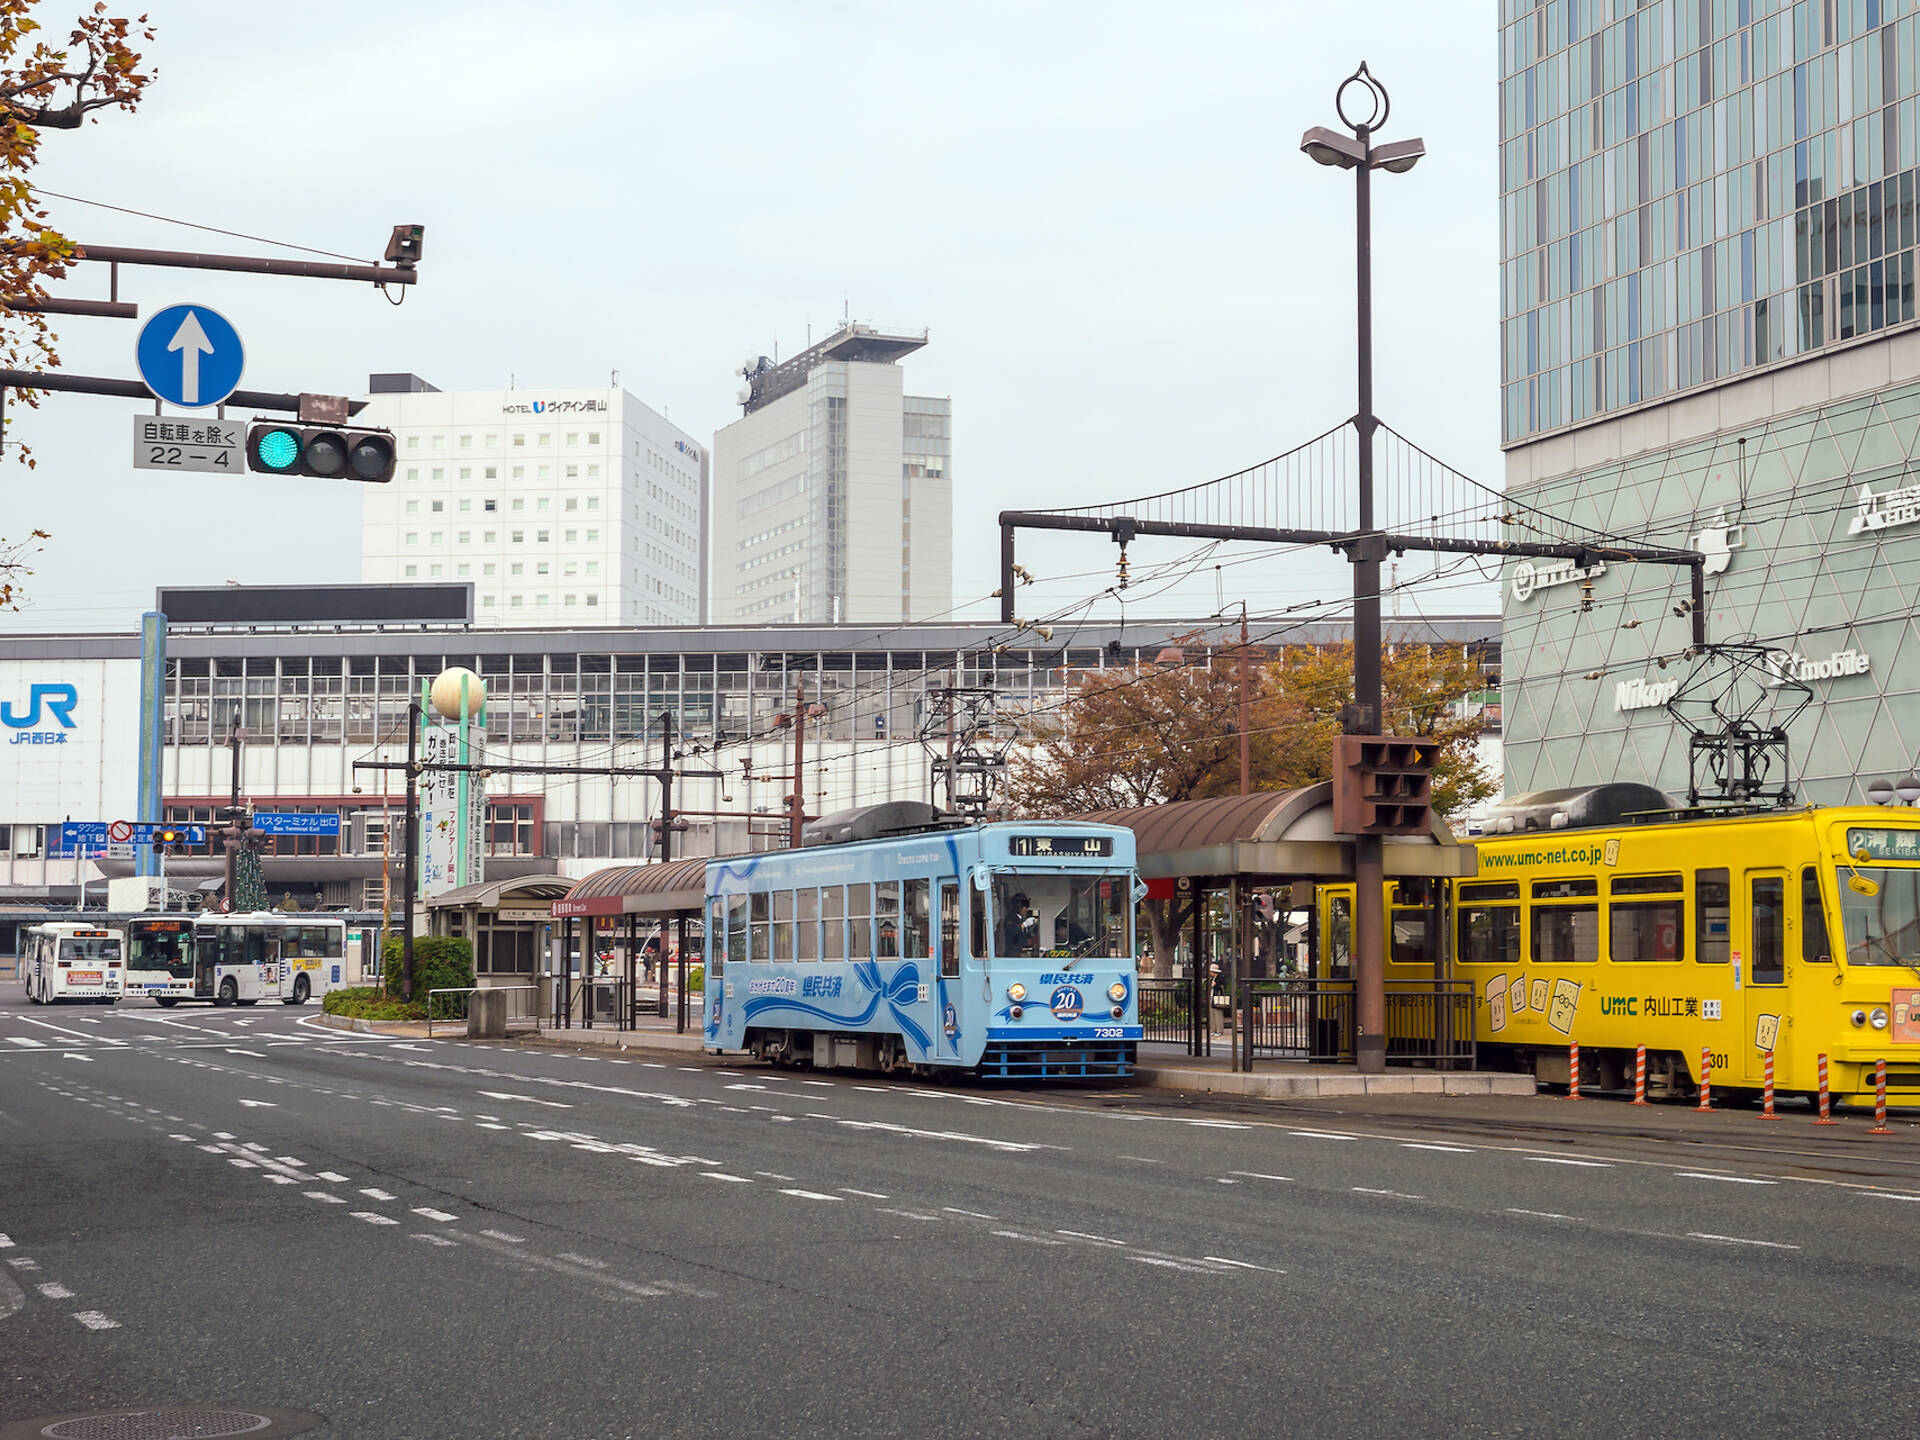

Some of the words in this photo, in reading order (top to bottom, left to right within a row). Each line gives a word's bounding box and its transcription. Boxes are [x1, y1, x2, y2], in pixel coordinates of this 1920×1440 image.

[502, 405, 531, 414] HOTEL
[548, 399, 607, 413] ヴィアイン岡山
[144, 421, 236, 445] 自転車を除く
[1614, 675, 1679, 712] Nikon
[1, 683, 78, 728] JR
[9, 731, 68, 745] JR西日本
[77, 824, 105, 833] タクシー
[1879, 847, 1920, 856] SEIKIBA
[1049, 950, 1071, 958] ワンマン
[1039, 973, 1095, 984] 県民共済
[802, 975, 843, 998] 県民共済
[1054, 992, 1076, 1010] 20
[1644, 995, 1698, 1017] 内山工業
[1094, 1028, 1124, 1038] 7302
